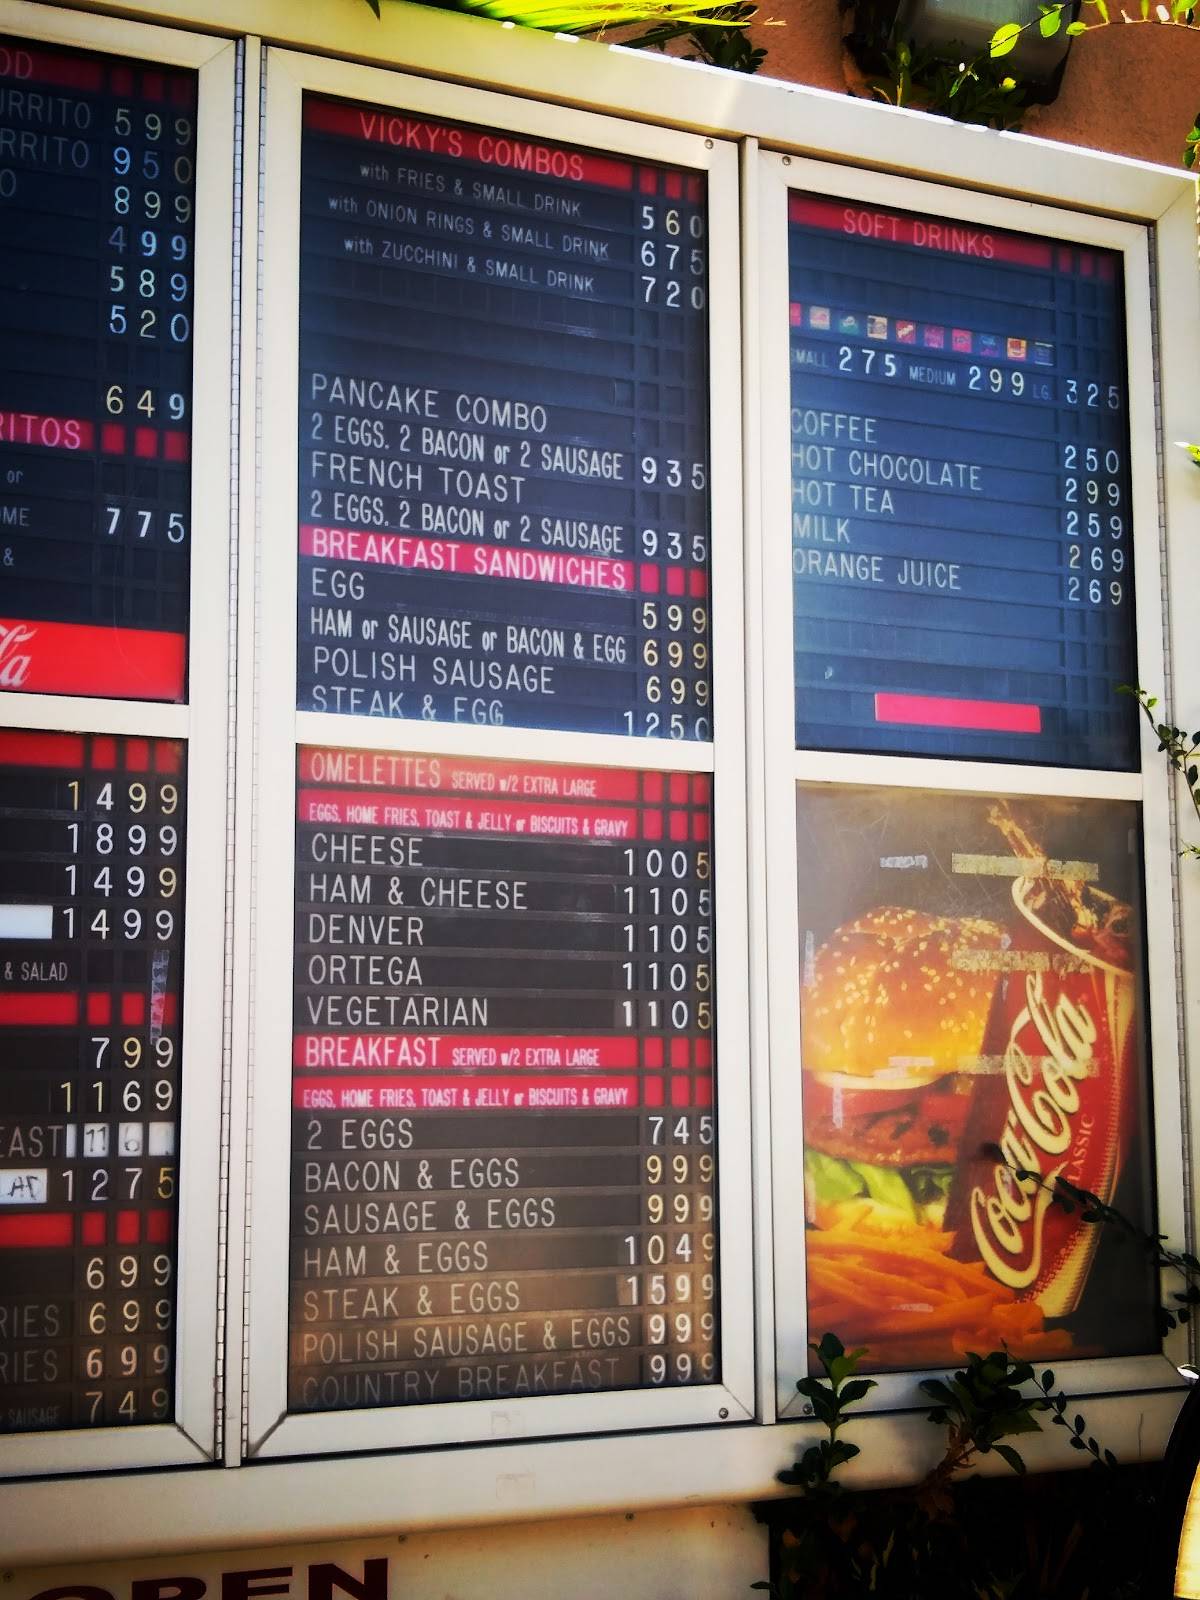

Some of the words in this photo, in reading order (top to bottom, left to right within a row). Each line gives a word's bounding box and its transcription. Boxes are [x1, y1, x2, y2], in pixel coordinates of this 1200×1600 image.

[359, 112, 463, 158] VICKY'S
[478, 136, 584, 182] COMBOS
[360, 163, 389, 182] with
[397, 167, 446, 192] FRIES
[453, 178, 463, 196] &
[473, 182, 528, 209] SMALL
[534, 193, 582, 217] DRINK
[328, 195, 358, 214] with
[366, 200, 417, 225] ONION
[426, 210, 474, 235] RINGS
[483, 220, 492, 238] &
[501, 224, 554, 250] SMALL
[562, 234, 609, 259] DRINK
[843, 209, 900, 241] SOFT
[913, 221, 994, 259] DRINKS
[344, 236, 374, 255] with
[382, 240, 458, 269] ZUCCHINI
[467, 256, 476, 273] &
[486, 259, 538, 284] SMALL
[547, 269, 595, 293] DRINK
[909, 366, 956, 386] MEDIUM
[312, 373, 439, 418] PANCAKE
[455, 394, 547, 433] COMBO
[312, 412, 323, 440] 2
[399, 424, 411, 452] 2
[422, 427, 485, 462] BACON
[494, 444, 511, 465] or
[519, 440, 531, 468] 2
[541, 443, 624, 480] SAUSAGE
[791, 408, 877, 444] COFFEE
[312, 451, 423, 492] FRENCH
[438, 466, 525, 504] TOAST
[791, 444, 835, 472] HOT
[849, 450, 984, 491] CHOCOLATE
[791, 480, 836, 506] HOT
[849, 485, 895, 514] TEA
[311, 490, 322, 518] 2
[399, 500, 411, 529] 2
[421, 502, 485, 537] BACON
[494, 519, 511, 540] or
[519, 515, 531, 543] 2
[541, 517, 624, 554] SAUSAGE
[793, 512, 850, 544] MILK
[312, 528, 460, 572] BREAKFAST
[473, 547, 625, 590] SANDWICHES
[792, 548, 884, 582] ORANGE
[898, 559, 961, 590] JUICE
[312, 567, 365, 600] EGG
[311, 607, 352, 638] HAM
[362, 619, 379, 640] or
[388, 614, 472, 649] SAUSAGE
[482, 631, 497, 651] or
[506, 625, 564, 658] BACON
[573, 632, 584, 660] &
[593, 634, 626, 663] EGG
[314, 646, 415, 682] POLISH
[433, 656, 555, 695] SAUSAGE
[312, 684, 404, 717] STEAK
[422, 694, 436, 721] &
[454, 696, 504, 726] EGG
[311, 752, 441, 789] OMELETTES
[451, 771, 495, 791] SERVED
[523, 775, 558, 795] EXTRA
[563, 777, 597, 798] LARGE
[346, 804, 378, 824] HOME
[425, 809, 460, 828] TOAST
[477, 811, 512, 832] JELLY
[530, 814, 578, 835] BISCUITS
[594, 818, 628, 837] GRAVY
[311, 832, 423, 867] CHEESE
[310, 873, 371, 904] HAM
[388, 876, 403, 905] &
[421, 877, 528, 910] CHEESE
[309, 913, 424, 946] DENVER
[21, 961, 68, 981] SALAD
[308, 954, 423, 986] ORTEGA
[307, 995, 488, 1026] VEGETARIAN
[305, 1036, 441, 1067] BREAKFAST
[452, 1048, 496, 1066] SERVED
[525, 1048, 561, 1066] EXTRA
[565, 1048, 600, 1067] LARGE
[341, 1089, 374, 1108] HOME
[421, 1088, 458, 1107] TOAST
[475, 1088, 509, 1106] JELLY
[528, 1087, 577, 1106] BISCUITS
[593, 1087, 628, 1105] GRAVY
[307, 1119, 322, 1150] 2
[342, 1118, 413, 1149] EGGS
[305, 1160, 400, 1193] BACON
[417, 1160, 433, 1190] &
[451, 1158, 519, 1188] EGGS
[304, 1201, 437, 1235] SAUSAGE
[455, 1200, 470, 1230] &
[487, 1197, 555, 1229] EGGS
[304, 1245, 366, 1278] HAM
[384, 1244, 400, 1275] &
[418, 1240, 488, 1273] EGGS
[304, 1287, 399, 1321] STEAK
[417, 1285, 433, 1316] &
[451, 1280, 520, 1314] EGGS
[304, 1329, 398, 1364] POLISH
[414, 1321, 527, 1358] SAUSAGE
[543, 1320, 557, 1349] &
[571, 1316, 631, 1348] EGGS
[302, 1370, 439, 1407] COUNTRY
[458, 1358, 620, 1399] BREAKFAST
